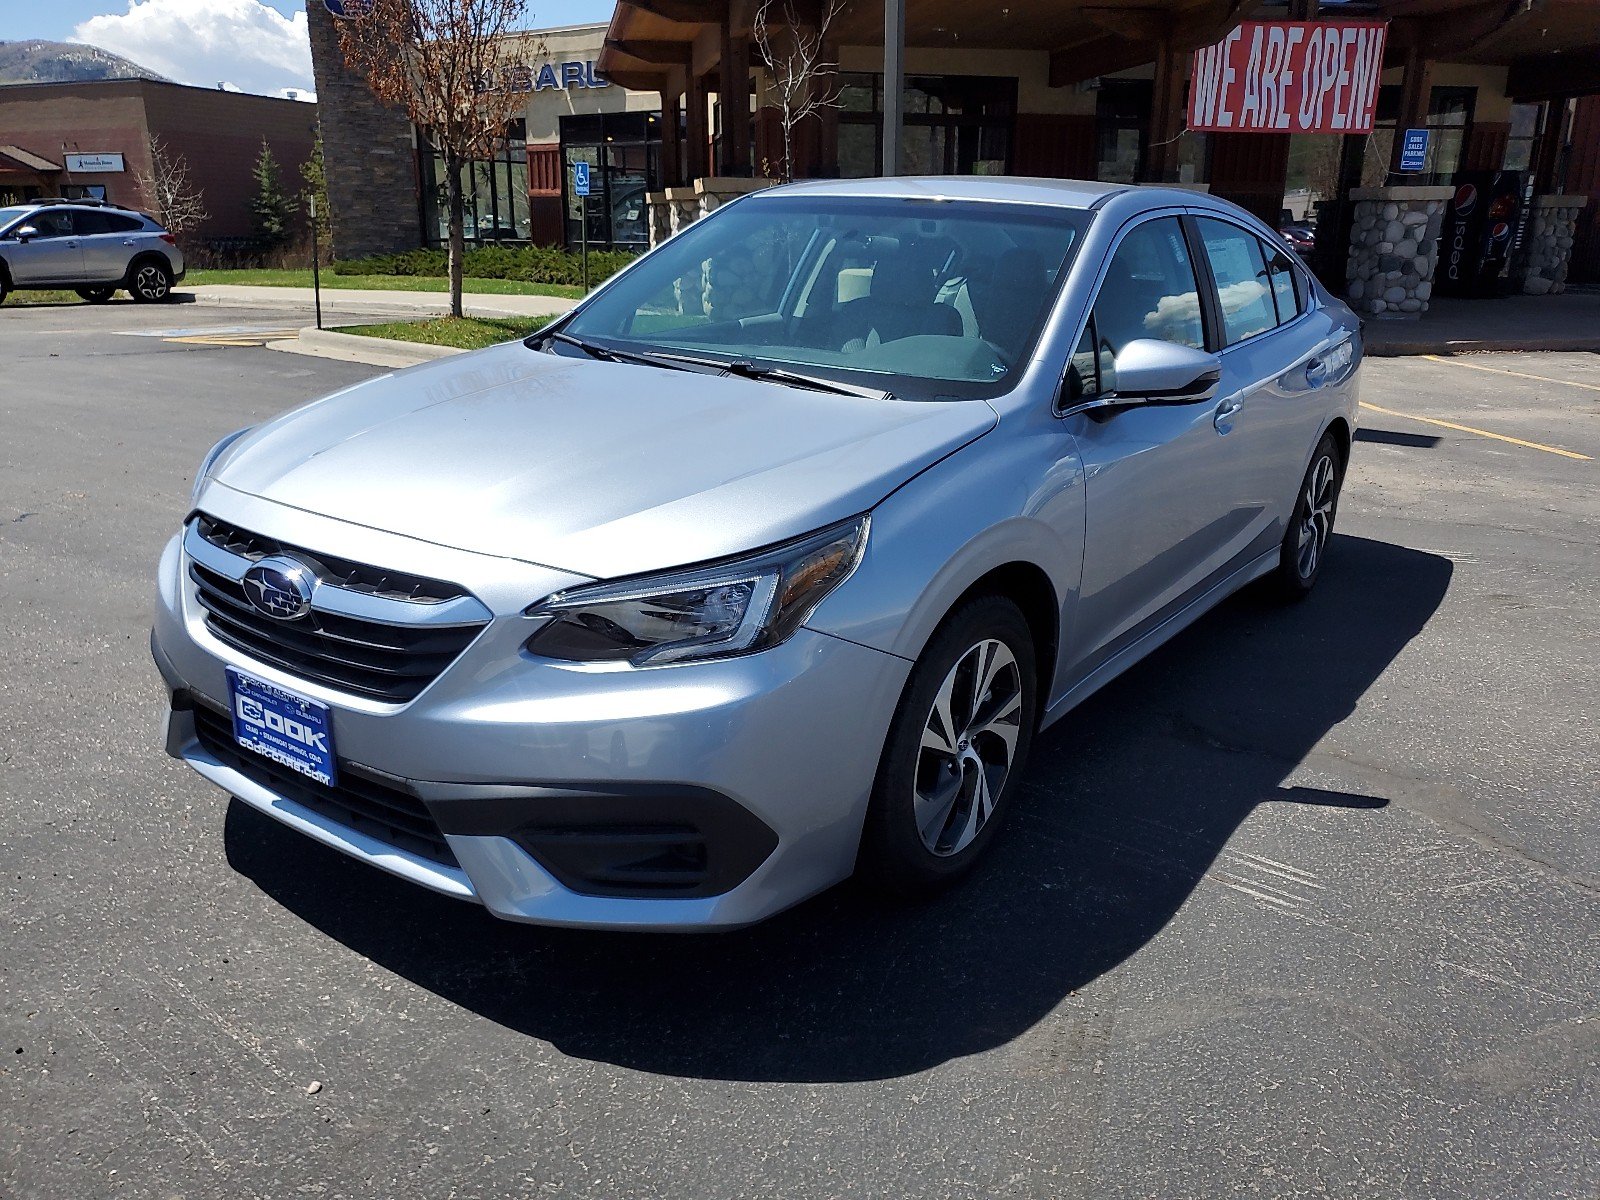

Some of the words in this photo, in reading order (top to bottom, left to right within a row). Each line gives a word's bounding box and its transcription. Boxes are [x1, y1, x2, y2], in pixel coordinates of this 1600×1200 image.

[1194, 25, 1242, 127] WE
[1239, 25, 1304, 128] ARE
[1298, 26, 1384, 129] OPEN!
[1448, 220, 1467, 280] pepsi
[296, 709, 322, 725] SUBARU
